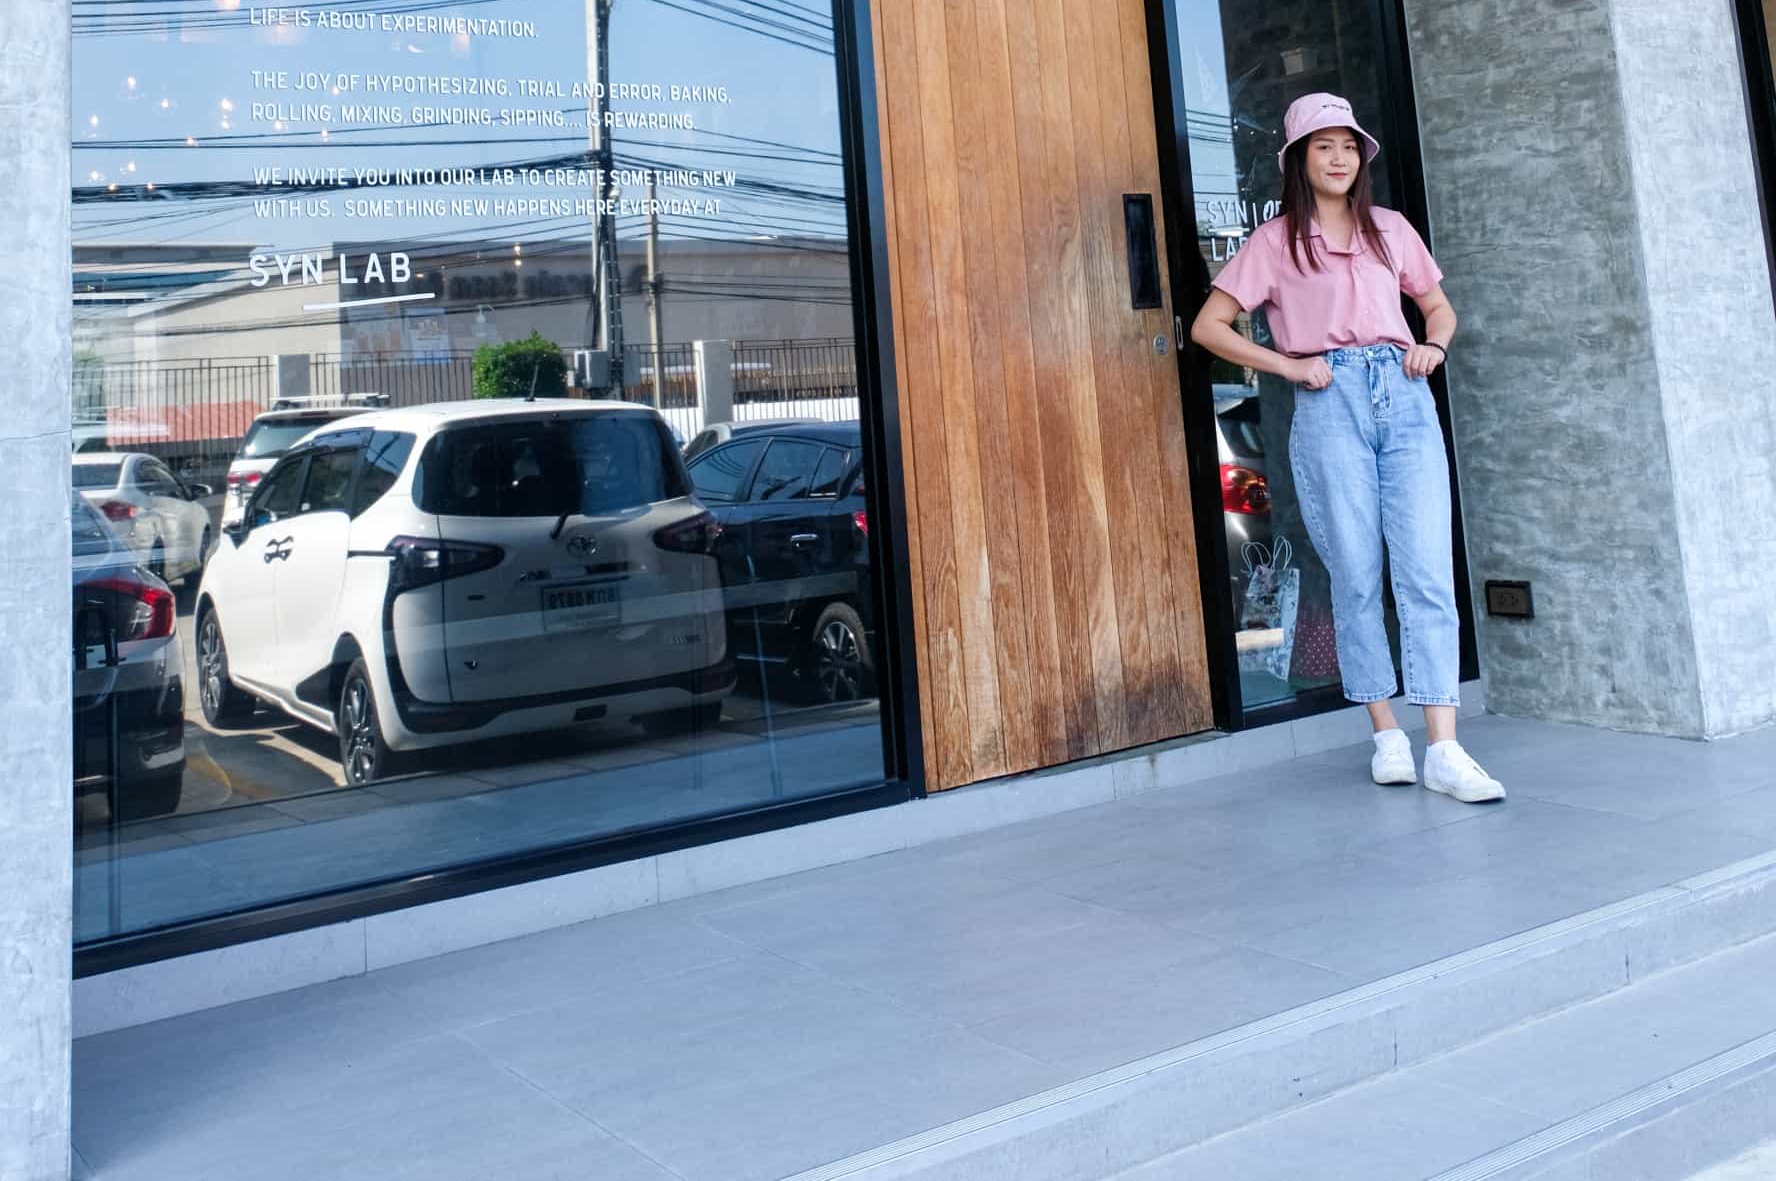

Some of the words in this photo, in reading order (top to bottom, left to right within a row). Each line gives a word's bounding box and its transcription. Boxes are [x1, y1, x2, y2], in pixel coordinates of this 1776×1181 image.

[250, 8, 289, 26] LIFE
[295, 10, 311, 27] IS
[317, 11, 376, 30] ABOUT
[251, 70, 288, 90] THE
[294, 72, 331, 91] JOY
[336, 74, 360, 91] OF
[518, 79, 565, 98] TRIAL
[571, 82, 604, 100] AND
[609, 83, 665, 102] ERROR,
[411, 107, 496, 127] GRINDING,
[586, 111, 600, 127] IS
[604, 111, 697, 130] REWARDING.
[253, 167, 283, 185] WE
[288, 167, 348, 185] INVITE
[353, 168, 390, 185] YOU
[395, 168, 435, 185] INTO
[440, 168, 475, 185] OUR
[480, 168, 514, 185] LAB
[519, 169, 540, 185] TO
[544, 169, 606, 186] CREATE
[611, 169, 699, 187] SOMETHING
[703, 170, 736, 186] NEW
[254, 200, 301, 218] WITH
[344, 199, 446, 218] SOMETHING
[451, 199, 489, 216] NEW
[494, 199, 569, 216] HAPPENS
[575, 199, 616, 215] HERE
[620, 199, 697, 215] EVERYDAY
[704, 199, 721, 215] AT
[1207, 200, 1248, 224] SYN
[250, 253, 323, 287] SYN
[340, 252, 411, 284] LAB
